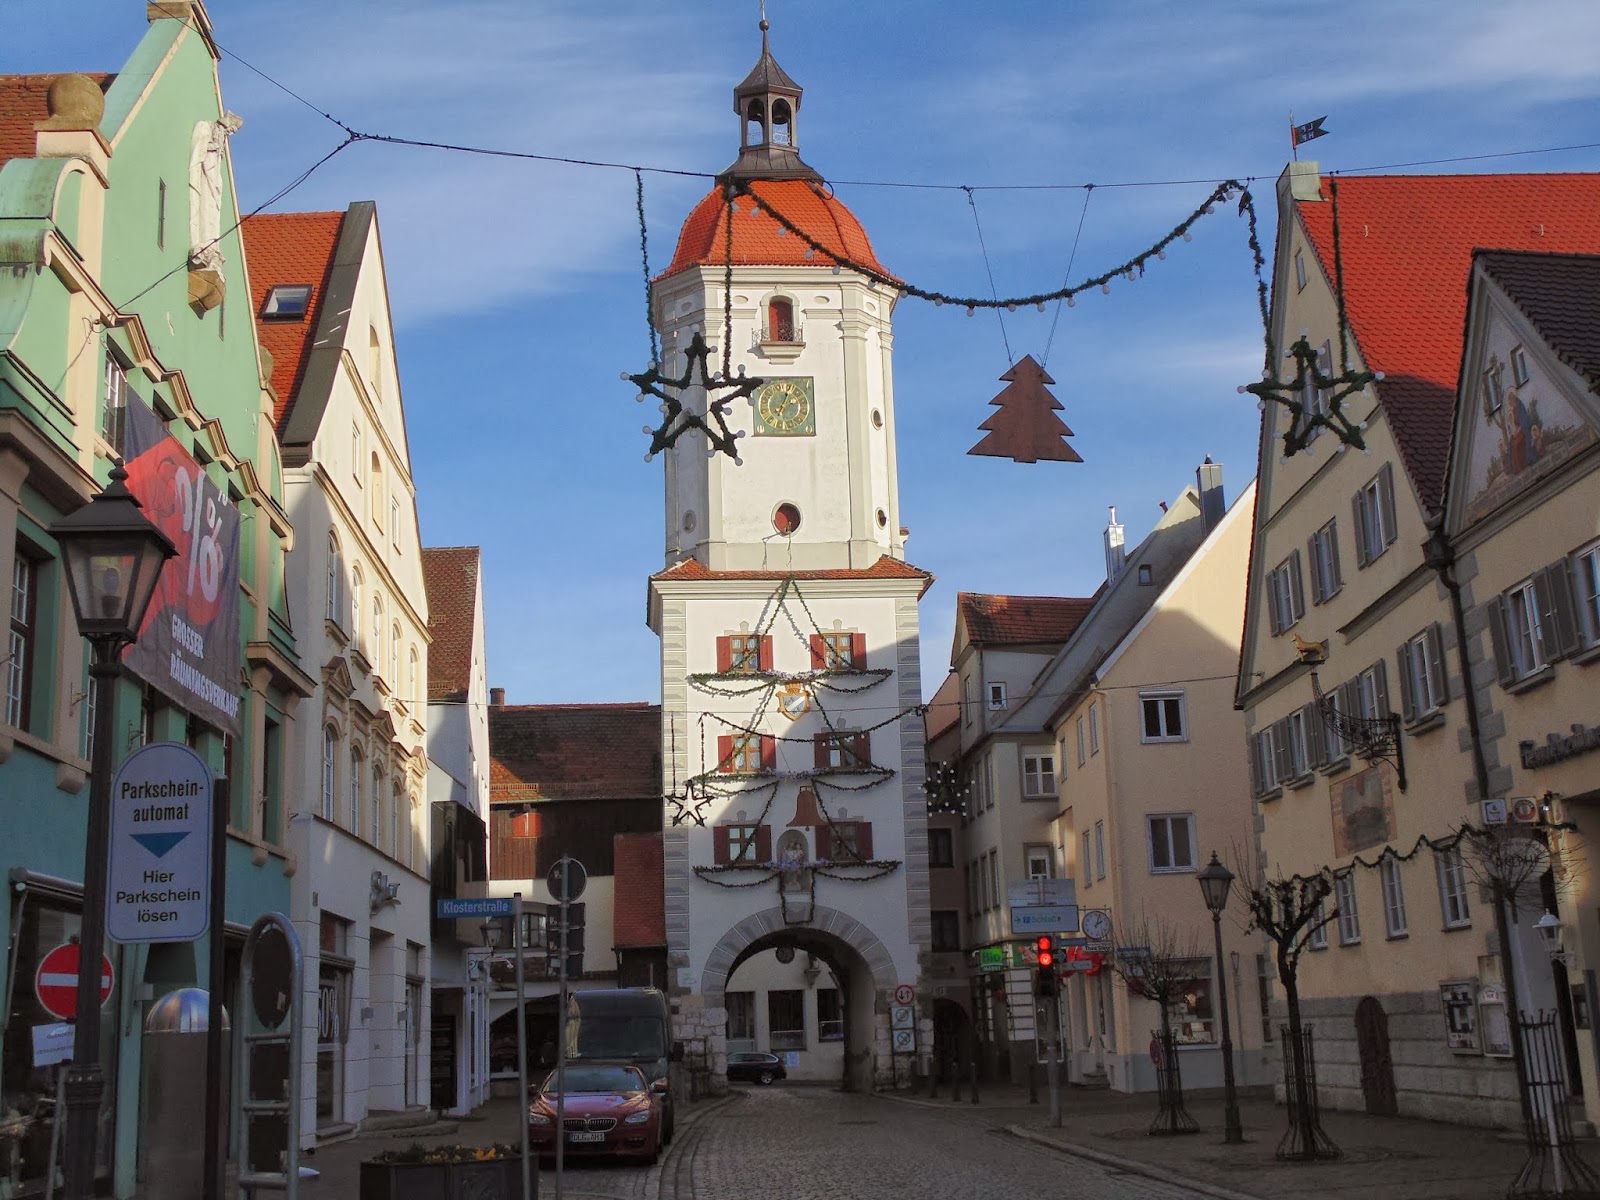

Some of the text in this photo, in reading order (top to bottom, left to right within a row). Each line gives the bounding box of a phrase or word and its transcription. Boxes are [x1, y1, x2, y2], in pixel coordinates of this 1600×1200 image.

[172, 614, 204, 659] GROSSER
[170, 648, 239, 718] RÄUMUNGSVERKAUF
[121, 779, 204, 800] Parkschein-
[133, 803, 189, 822] automat
[143, 870, 175, 883] Hier
[116, 888, 201, 904] Parkschein
[443, 900, 508, 914] Klosterstraße
[137, 909, 178, 923] lösen
[982, 951, 1001, 963] Bio
